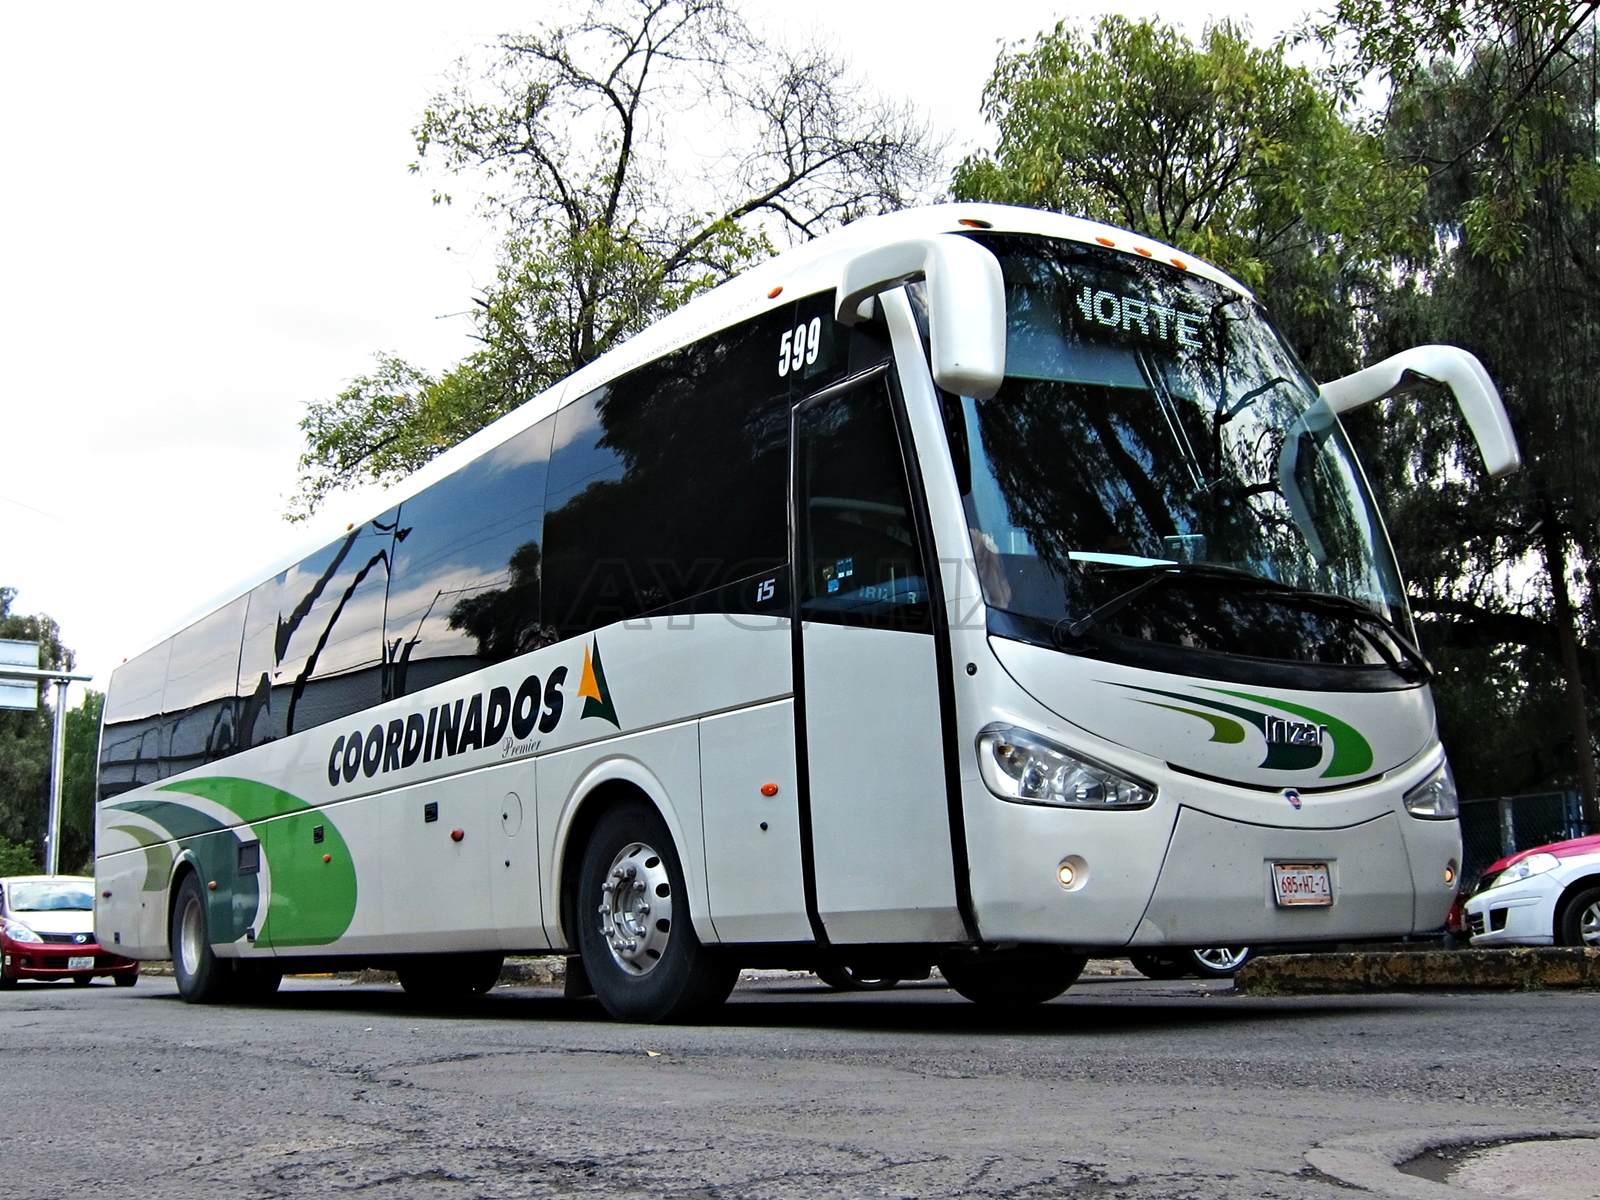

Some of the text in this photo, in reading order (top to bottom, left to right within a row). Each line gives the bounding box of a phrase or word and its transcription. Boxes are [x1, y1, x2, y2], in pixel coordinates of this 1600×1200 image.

[1076, 286, 1203, 348] NORTE
[778, 316, 822, 377] 599
[757, 578, 776, 602] i5
[859, 585, 918, 604] IRIZR
[328, 665, 569, 787] COORDINADOS
[502, 737, 541, 758] Premier
